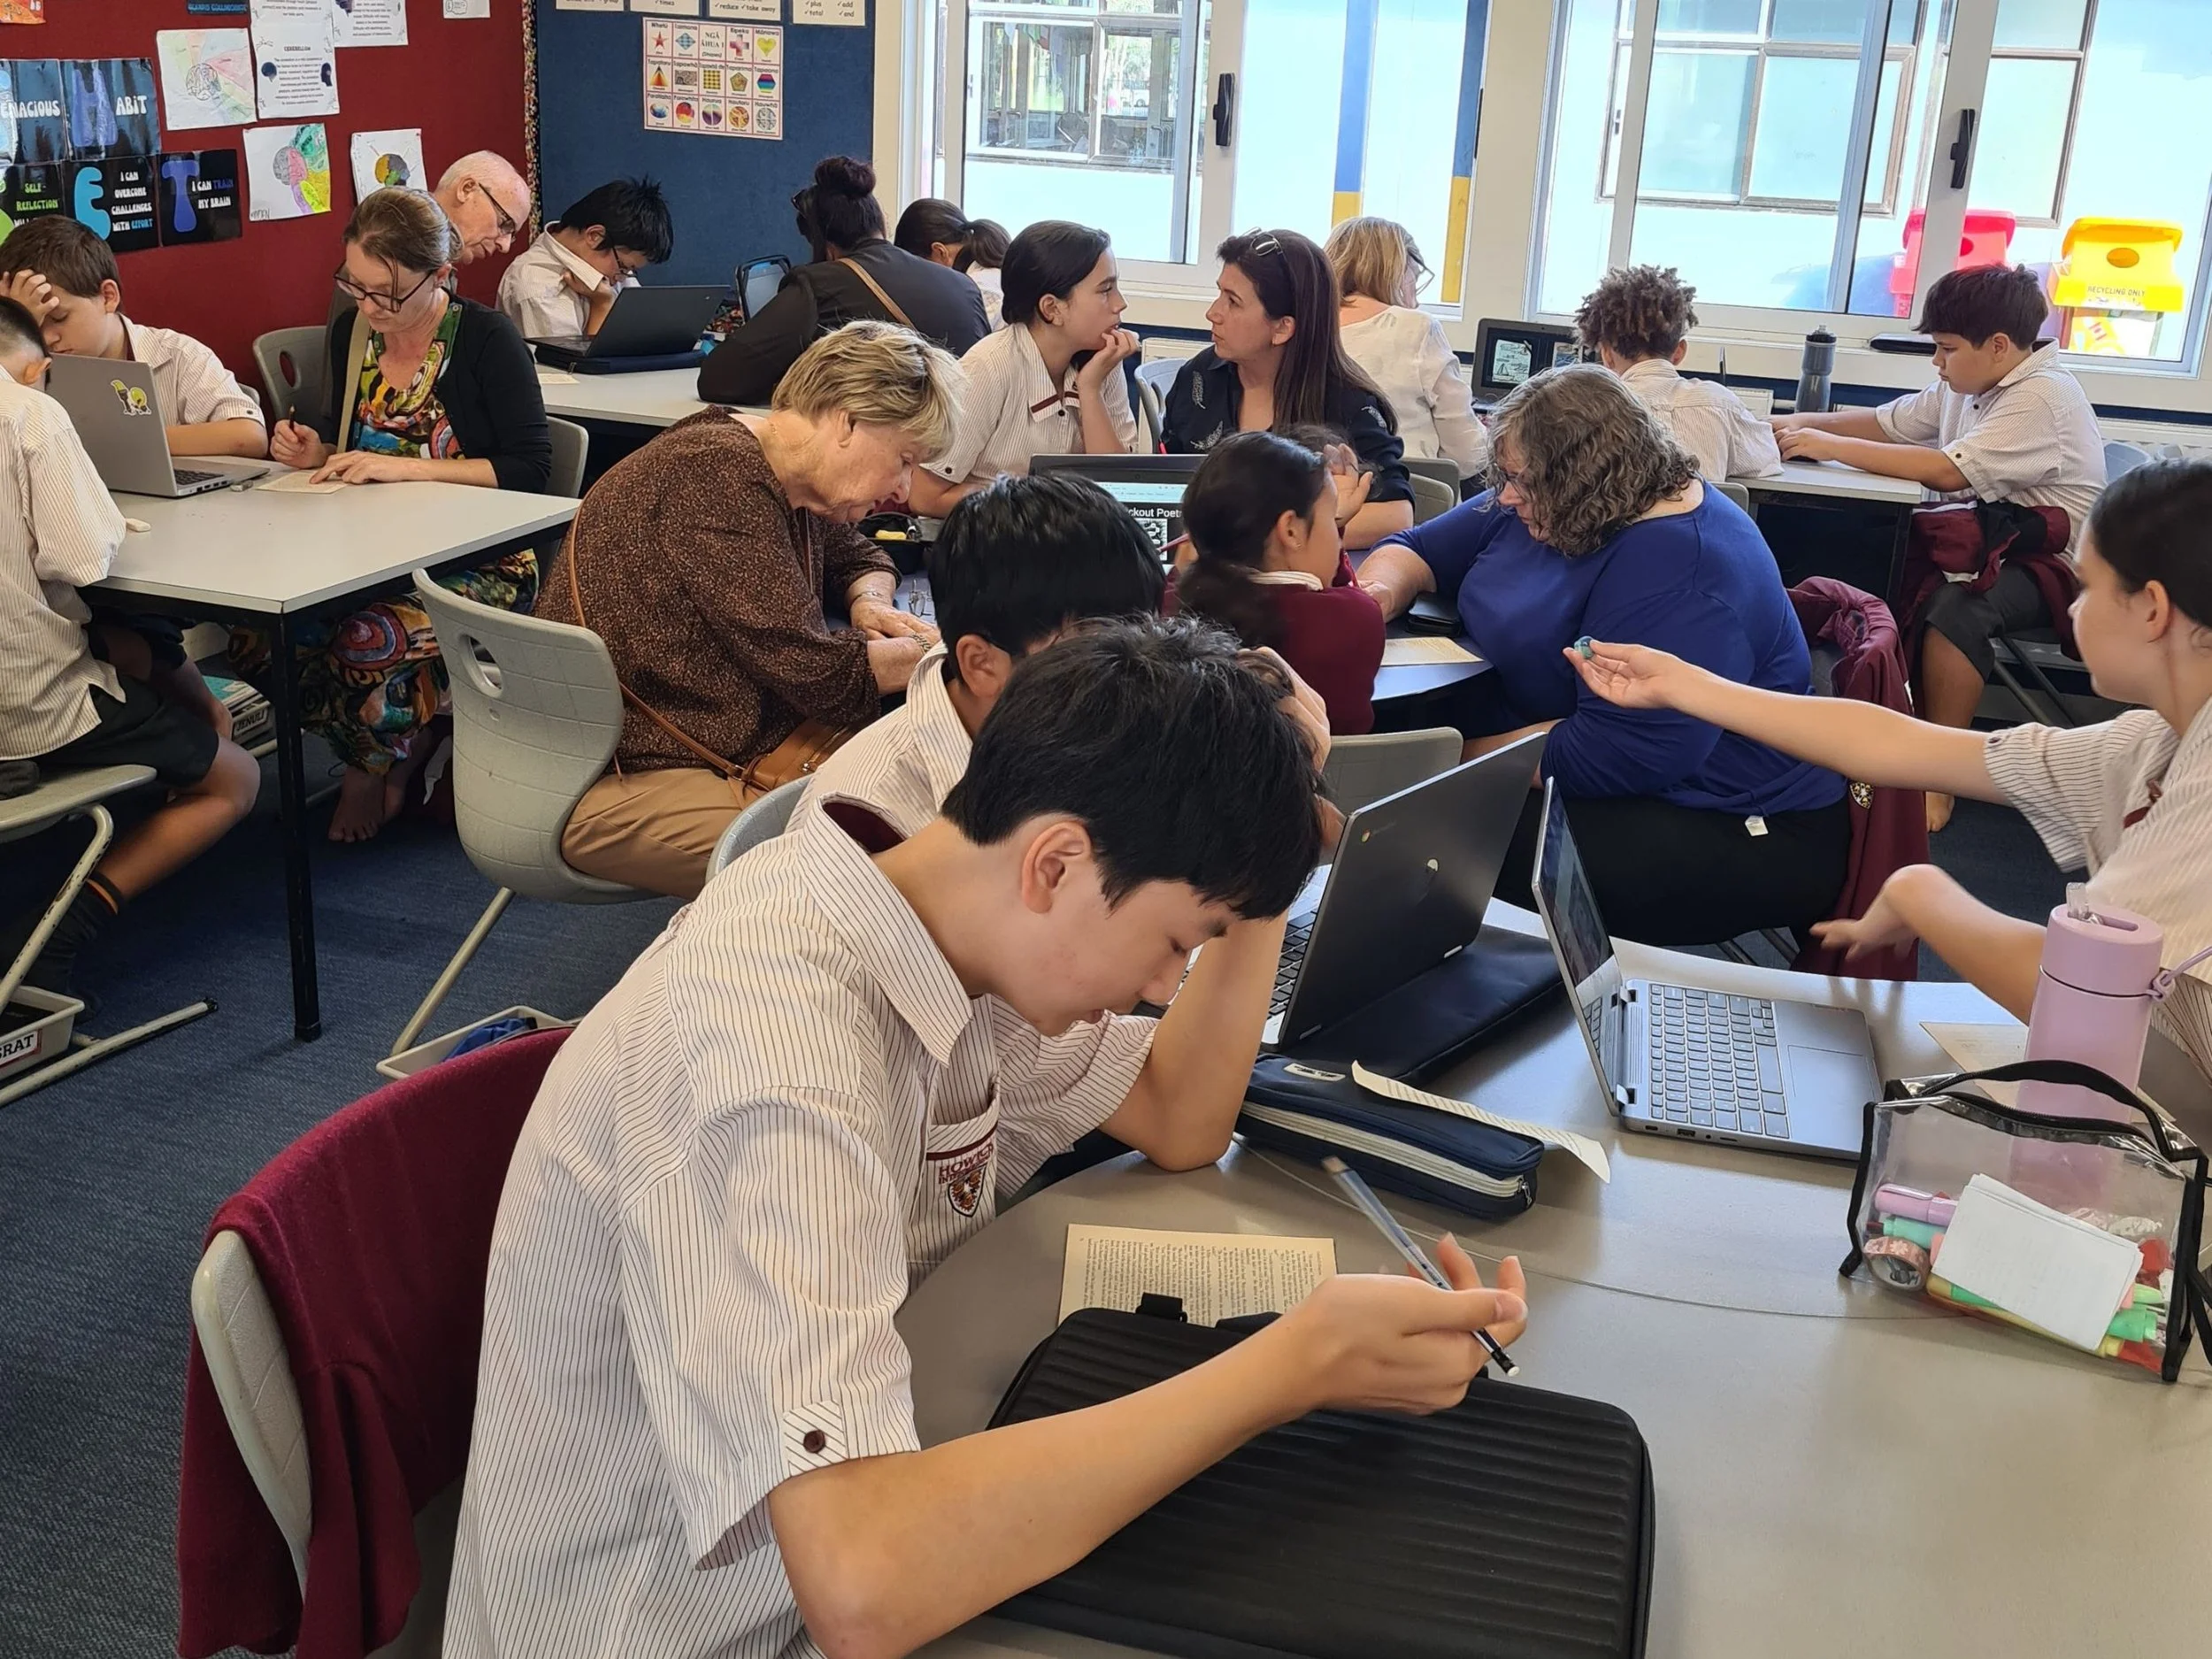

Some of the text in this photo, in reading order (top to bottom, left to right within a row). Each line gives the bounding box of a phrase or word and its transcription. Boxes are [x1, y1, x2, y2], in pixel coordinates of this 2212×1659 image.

[196, 180, 212, 191] CAN
[111, 203, 152, 216] CHALLENGES
[198, 198, 210, 210] MY
[2087, 286, 2145, 297] RECYCLING ONLY
[0, 1033, 34, 1059] RAT
